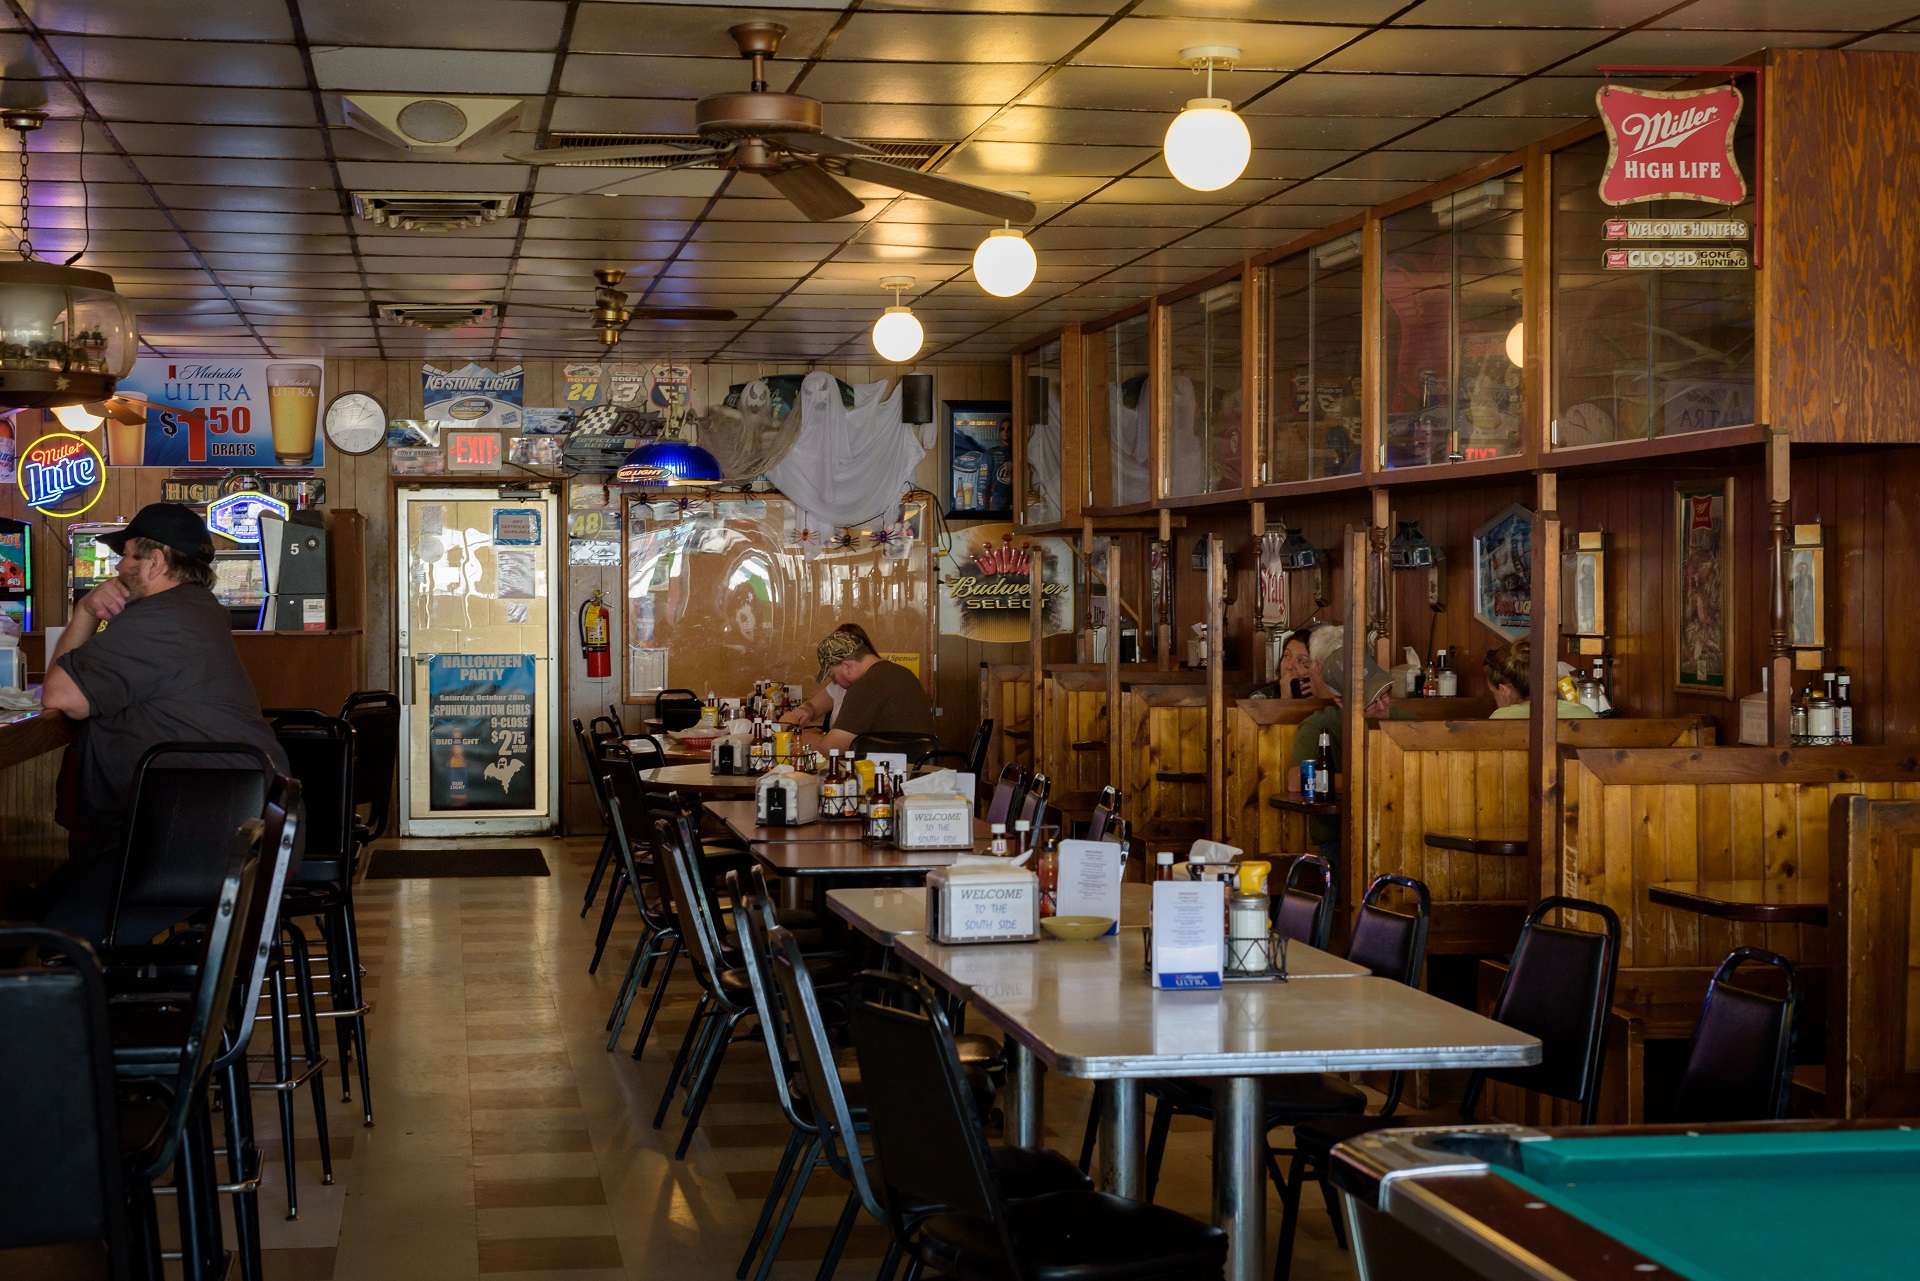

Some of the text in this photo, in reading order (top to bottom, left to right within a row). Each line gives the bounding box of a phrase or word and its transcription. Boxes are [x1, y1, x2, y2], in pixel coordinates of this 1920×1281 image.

[1621, 105, 1719, 152] Miller
[1624, 160, 1721, 179] HIGH LIFE
[1628, 223, 1688, 236] WELCOME
[1692, 223, 1745, 236] HUNTERS
[1628, 250, 1698, 267] CLOSED
[1700, 251, 1731, 259] GONE
[1700, 259, 1746, 267] HUNTING
[180, 364, 244, 380] Michelob
[425, 376, 520, 391] KEYSTONE LIGHT
[163, 383, 251, 401] ULTRA
[567, 384, 598, 401] 24
[612, 384, 640, 402] 3
[31, 442, 84, 467] Miller
[212, 443, 257, 457] DRAFTS
[455, 434, 496, 465] EXIT
[633, 469, 661, 477] LIGHT
[165, 482, 222, 502] HIGH
[290, 543, 299, 555] 5
[442, 655, 521, 668] HALLOWEEN
[460, 668, 504, 681] PARTY
[506, 704, 531, 715] GIRLS
[491, 716, 528, 728] 9-CLOSE
[913, 812, 962, 822] WELCOME
[961, 888, 1023, 900] WELCOME
[974, 903, 1008, 914] TO THE
[965, 919, 1016, 930] SOUTH SIDE
[1175, 978, 1208, 987] ULTRA
